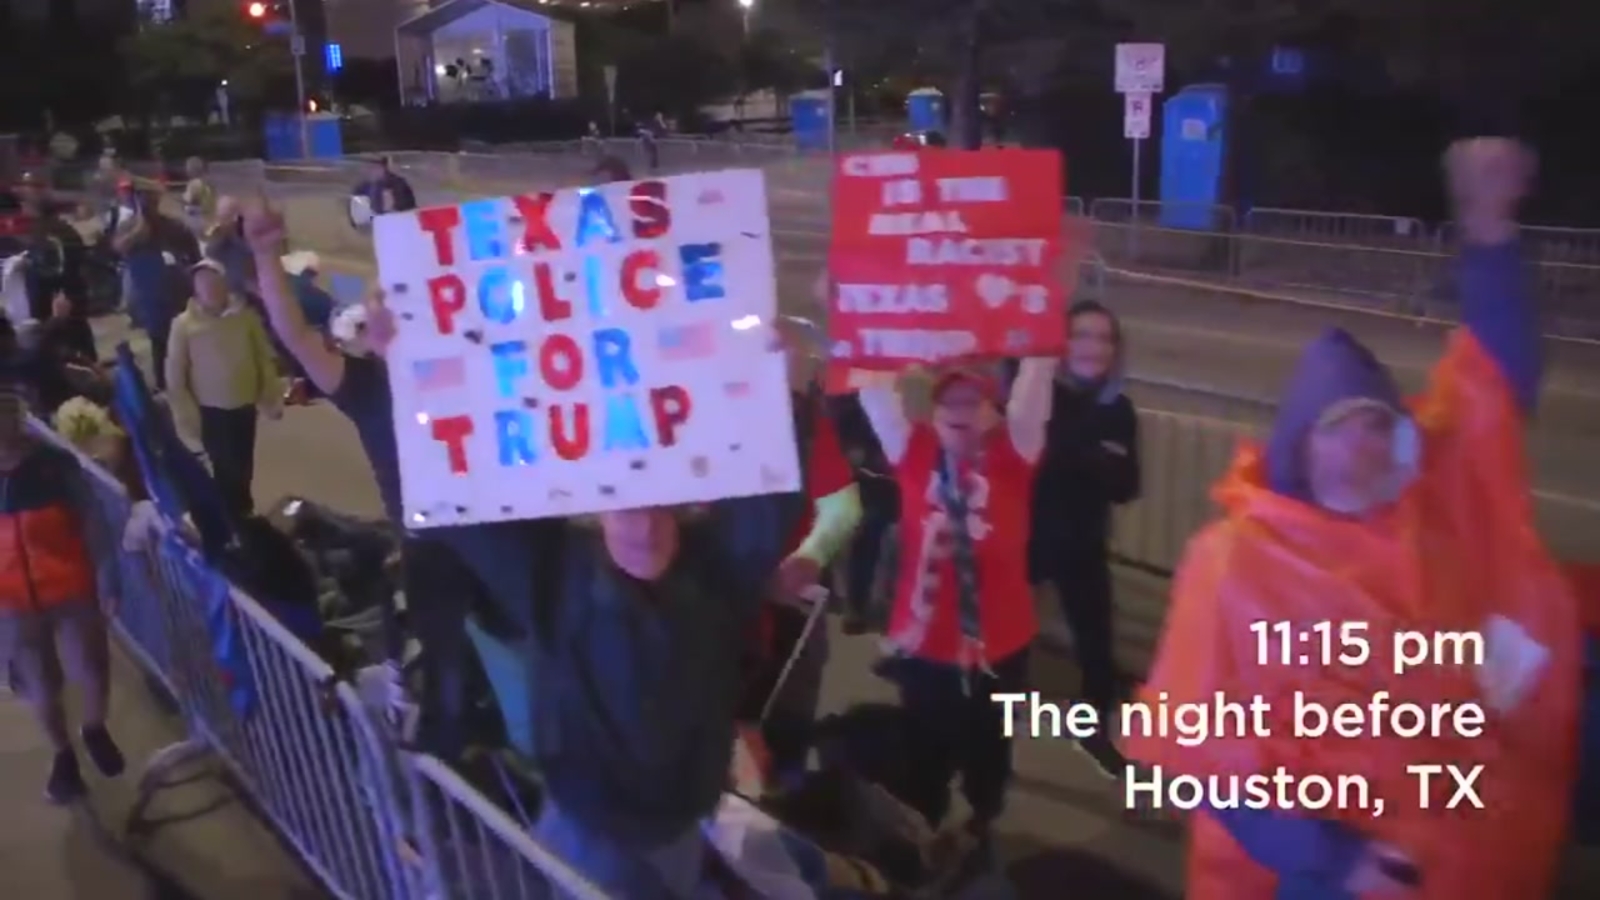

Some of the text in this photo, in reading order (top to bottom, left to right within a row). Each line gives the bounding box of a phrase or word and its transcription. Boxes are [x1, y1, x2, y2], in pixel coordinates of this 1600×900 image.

[418, 181, 671, 266] TEXAS
[906, 237, 1047, 266] RACIST
[428, 242, 726, 335] POLICE
[837, 283, 948, 313] TEXAS
[491, 327, 640, 397] FOR
[432, 385, 691, 475] TRUMP
